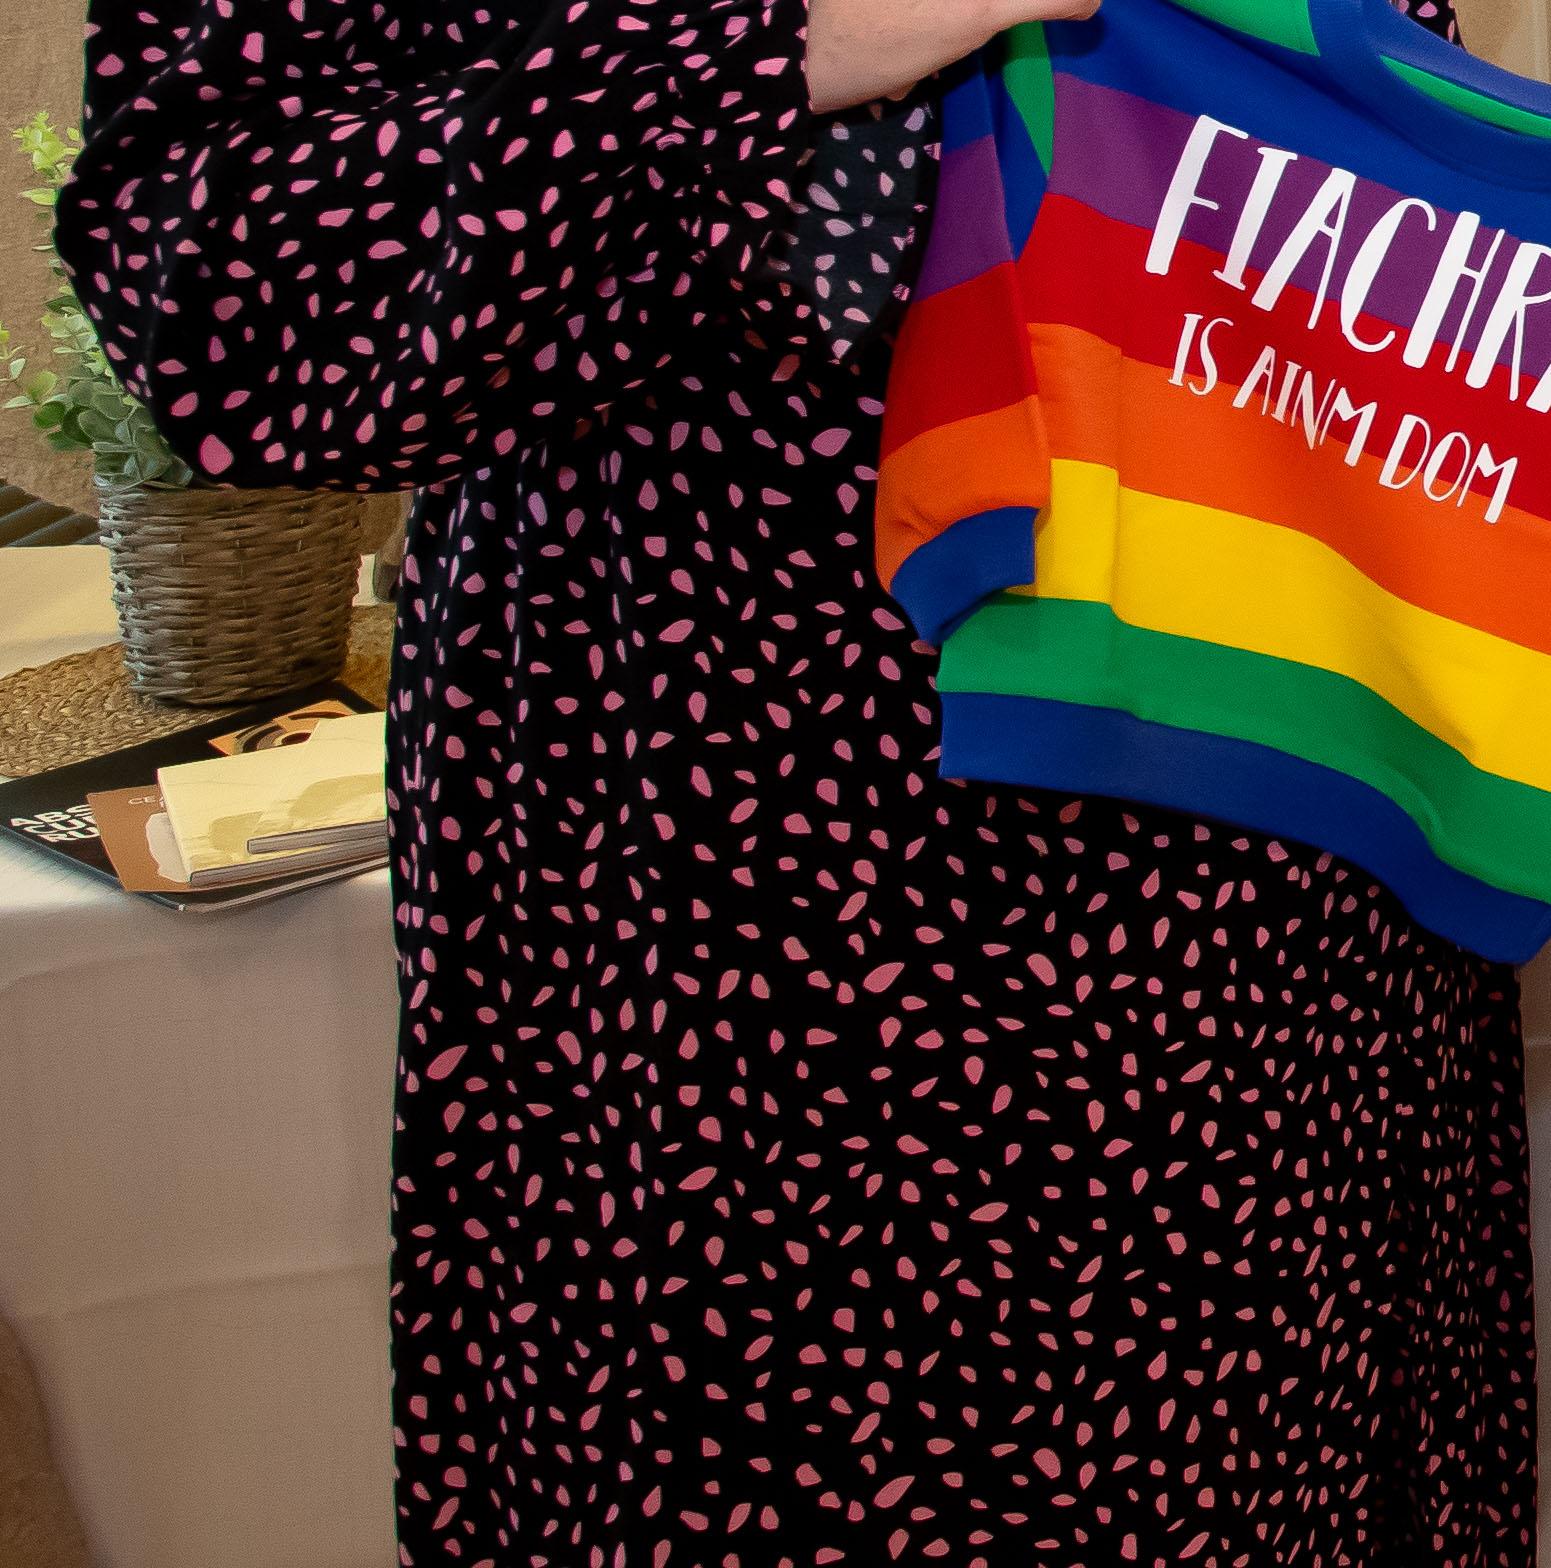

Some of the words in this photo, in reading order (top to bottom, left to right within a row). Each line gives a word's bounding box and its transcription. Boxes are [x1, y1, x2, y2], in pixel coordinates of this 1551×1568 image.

[1167, 313, 1234, 395] IS
[1232, 345, 1377, 468] AINM
[1378, 414, 1518, 524] DOM
